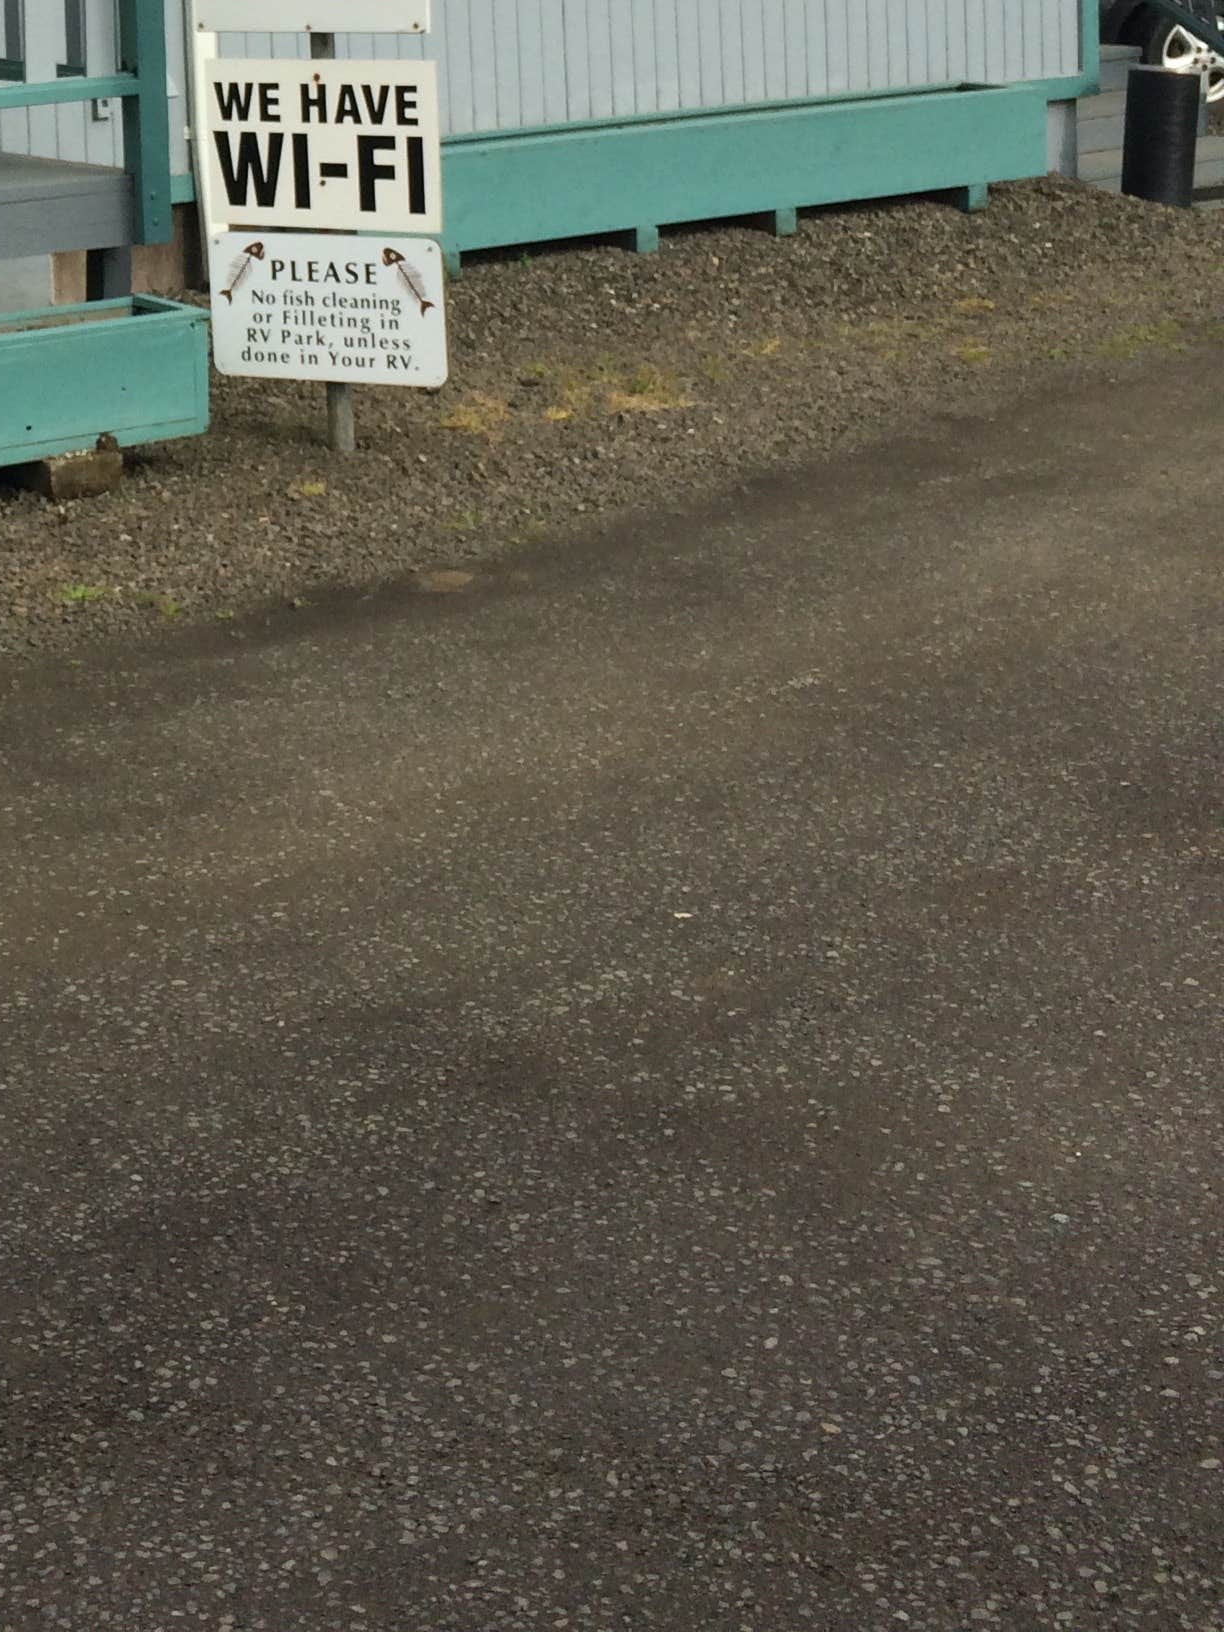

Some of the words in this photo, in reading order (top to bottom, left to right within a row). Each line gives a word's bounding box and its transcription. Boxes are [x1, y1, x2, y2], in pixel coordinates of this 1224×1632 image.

[214, 82, 280, 122] WE
[300, 83, 418, 125] HAVE
[213, 131, 425, 214] WI-FI
[271, 260, 376, 284] PLEASE
[252, 290, 275, 303] No
[283, 291, 314, 306] fish
[322, 292, 401, 316] cleaning
[252, 312, 272, 325] or
[282, 310, 370, 332] Filleting
[381, 314, 398, 329] in
[247, 327, 270, 343] RV
[281, 330, 334, 349] Park,
[344, 333, 410, 349] unless
[242, 346, 289, 363] done
[300, 351, 319, 366] in
[329, 352, 374, 367] Your
[386, 354, 419, 371] RV.
